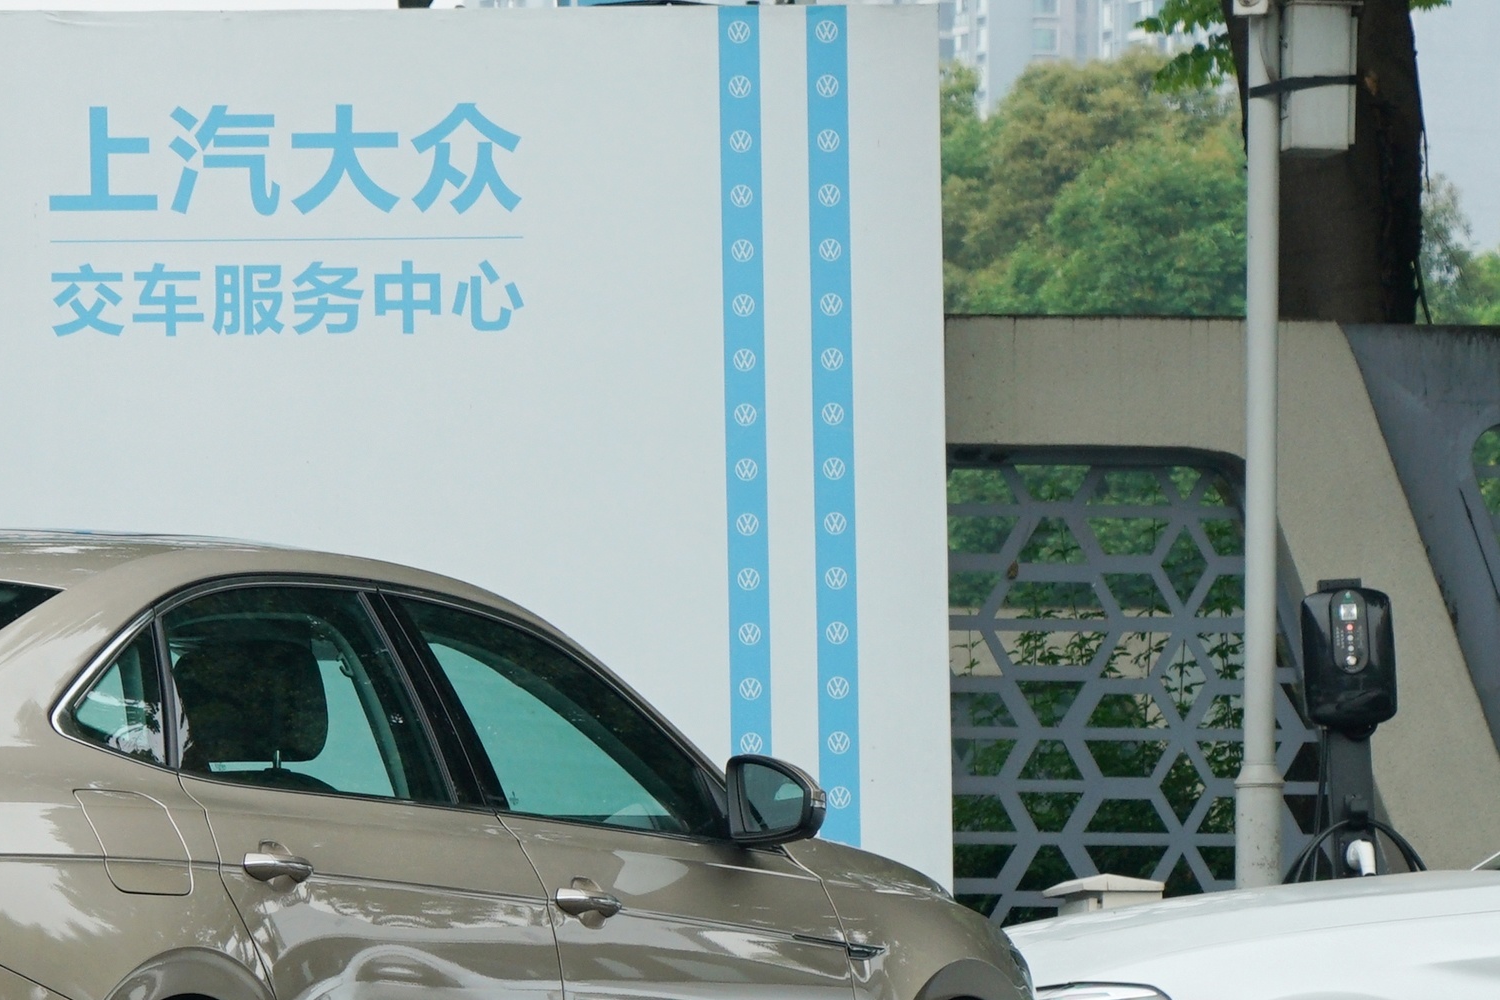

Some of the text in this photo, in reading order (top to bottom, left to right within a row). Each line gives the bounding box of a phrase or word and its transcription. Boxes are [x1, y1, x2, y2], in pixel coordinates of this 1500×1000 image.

[49, 102, 523, 218] 上汽大众
[51, 259, 525, 338] 交车服务中心
